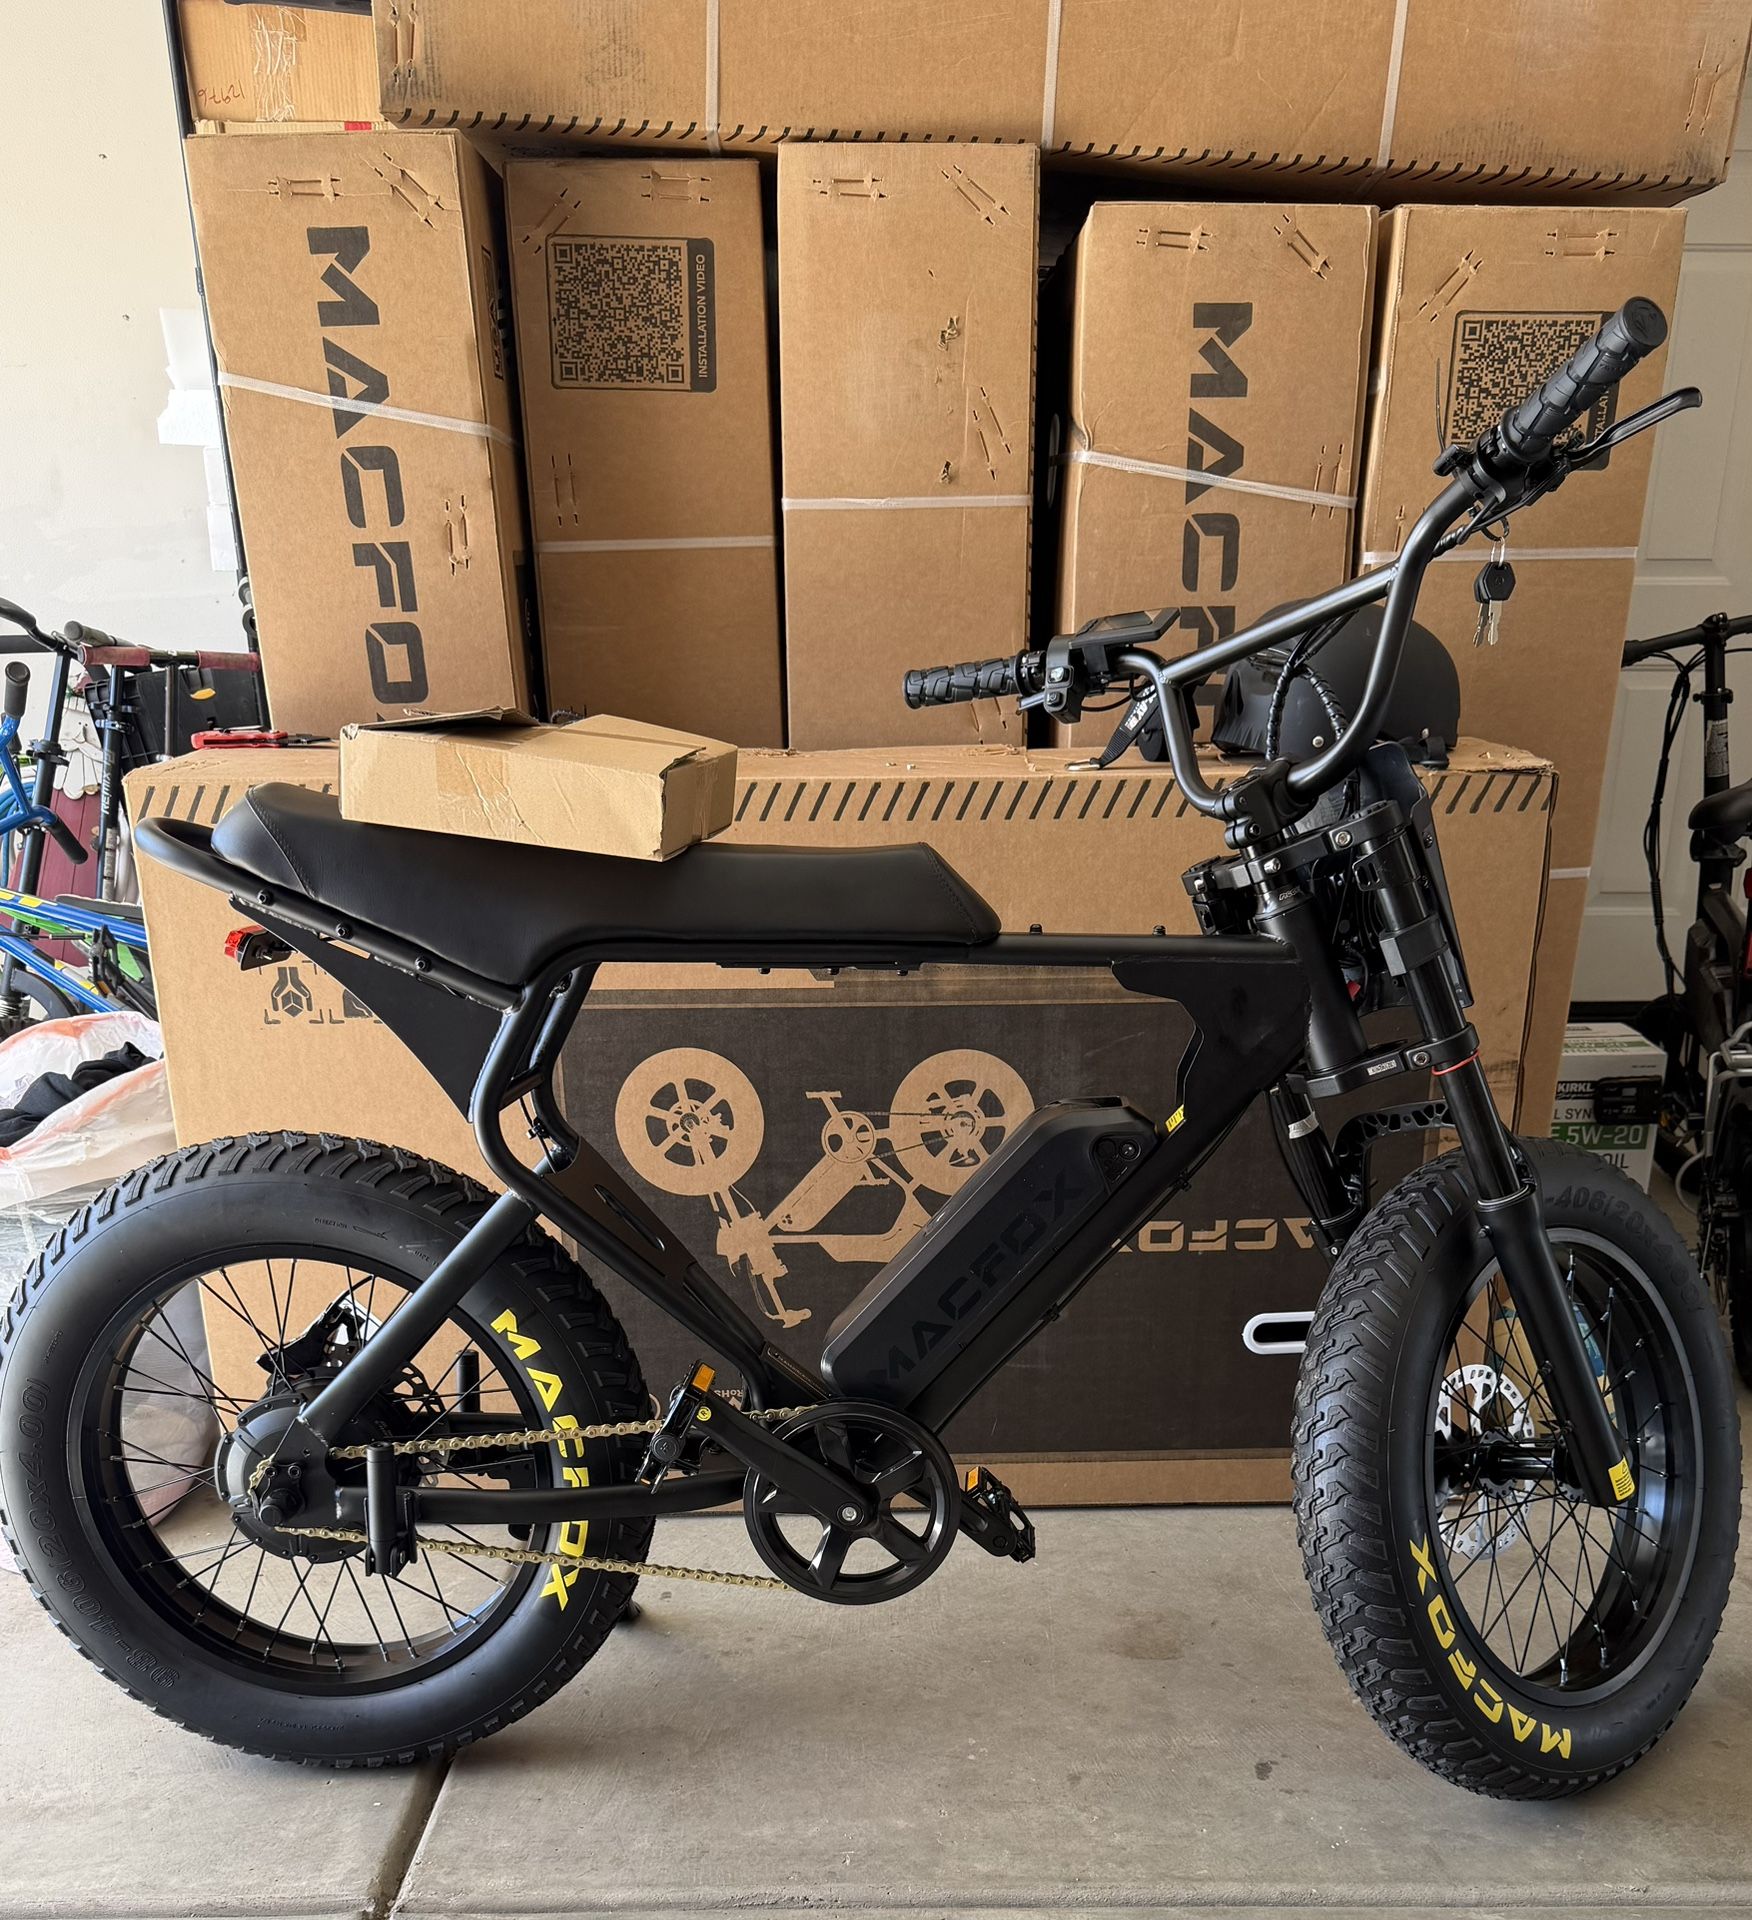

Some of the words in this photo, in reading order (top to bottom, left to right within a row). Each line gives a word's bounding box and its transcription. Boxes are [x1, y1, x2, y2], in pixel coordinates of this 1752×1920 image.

[696, 254, 706, 293] VIDEO
[697, 296, 709, 379] INSTALLATION
[306, 225, 429, 722] MACFO
[1566, 1126, 1643, 1145] 5W-20
[868, 1169, 1085, 1380] MACFOX
[1117, 1217, 1315, 1253] ACFO
[1409, 1532, 1572, 1760] MACFOX
